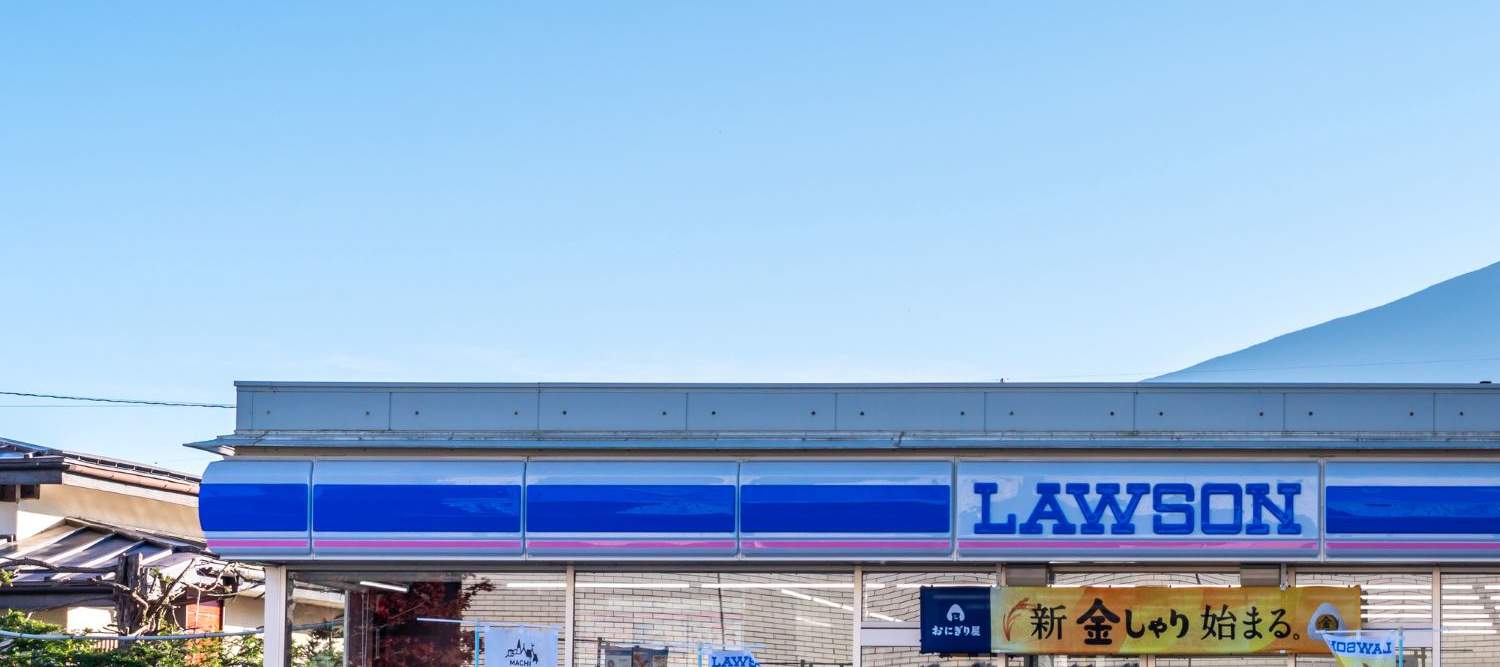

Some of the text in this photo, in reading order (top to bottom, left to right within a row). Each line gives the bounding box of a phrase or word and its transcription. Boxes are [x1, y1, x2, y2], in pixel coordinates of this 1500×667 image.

[973, 482, 1301, 535] LAWSON
[931, 625, 981, 637] おにぎり屋
